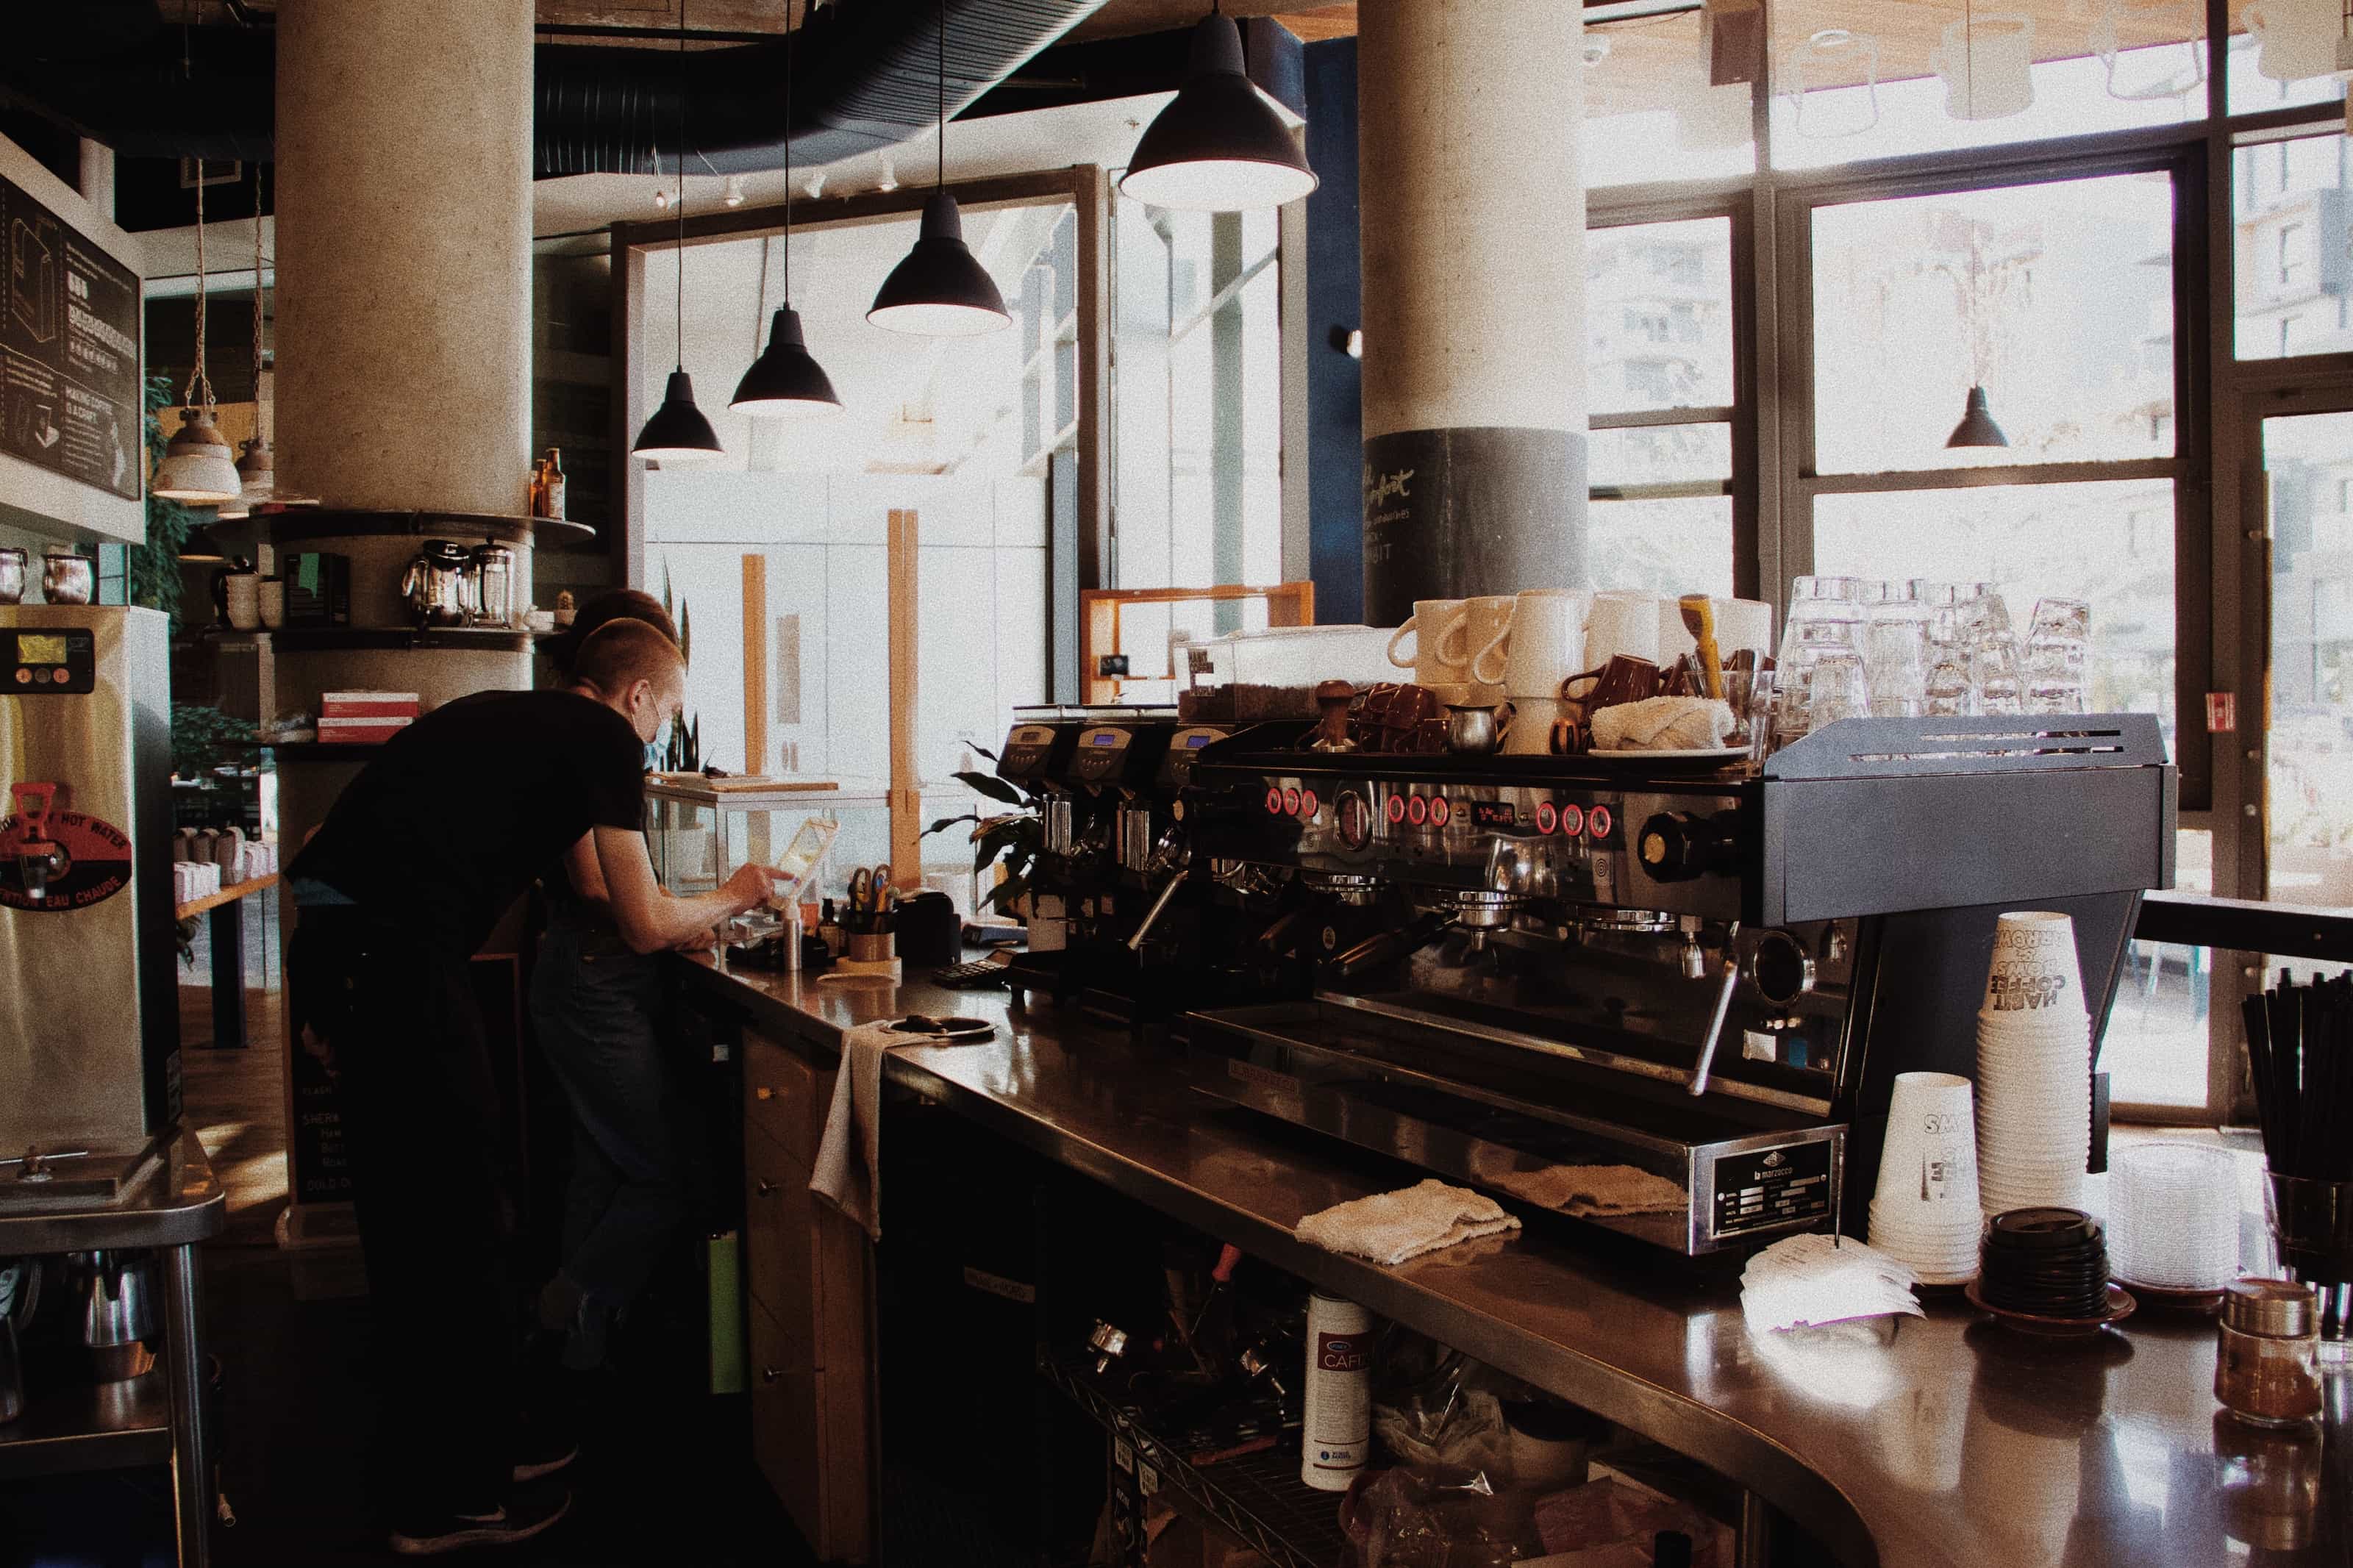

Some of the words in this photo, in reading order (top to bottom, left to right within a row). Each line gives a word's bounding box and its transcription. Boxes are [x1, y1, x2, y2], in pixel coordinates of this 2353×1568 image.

[62, 813, 86, 826] HOT
[90, 821, 126, 849] WATER
[47, 895, 69, 906] EAU
[76, 876, 121, 904] CHAUDE
[1990, 975, 2065, 994] COFFEE
[1993, 992, 2057, 1011] HABIT
[1762, 1167, 1793, 1179] marzocco
